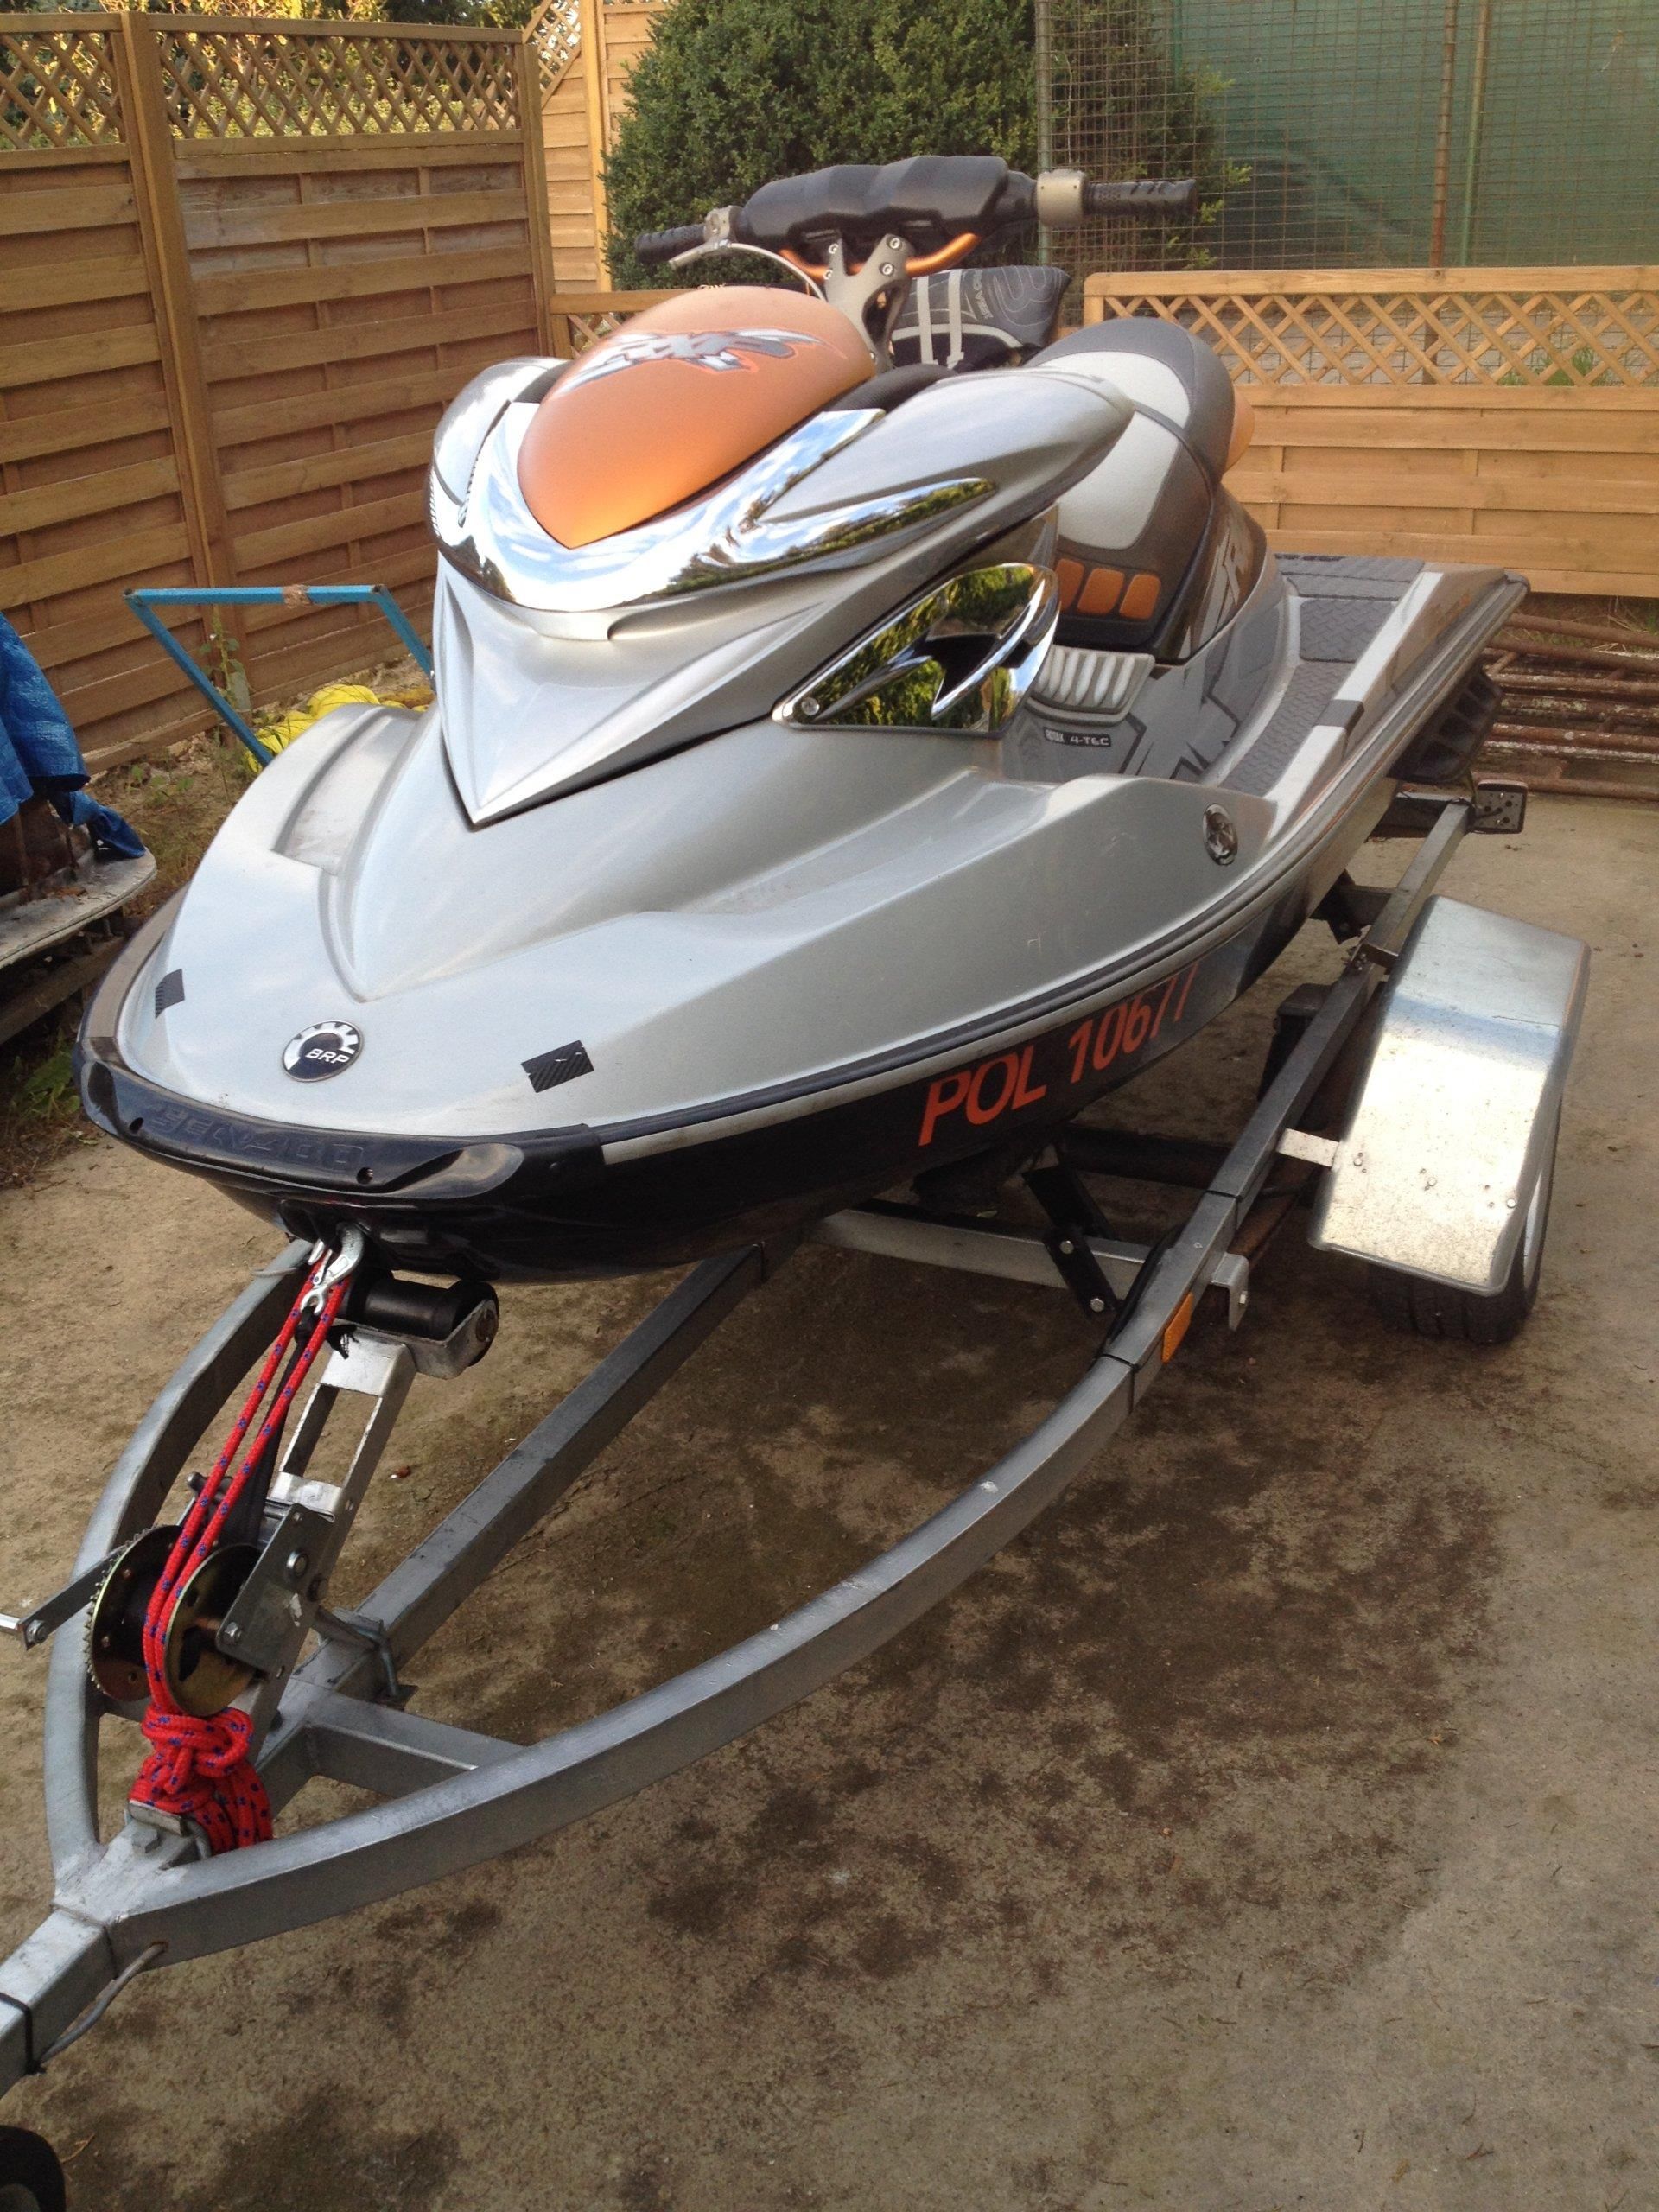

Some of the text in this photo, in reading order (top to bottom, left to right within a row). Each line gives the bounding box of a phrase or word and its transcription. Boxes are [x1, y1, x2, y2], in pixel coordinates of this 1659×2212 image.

[1071, 735, 1109, 746] 4-TEC
[304, 1048, 350, 1064] BRP
[918, 1044, 1047, 1147] POL
